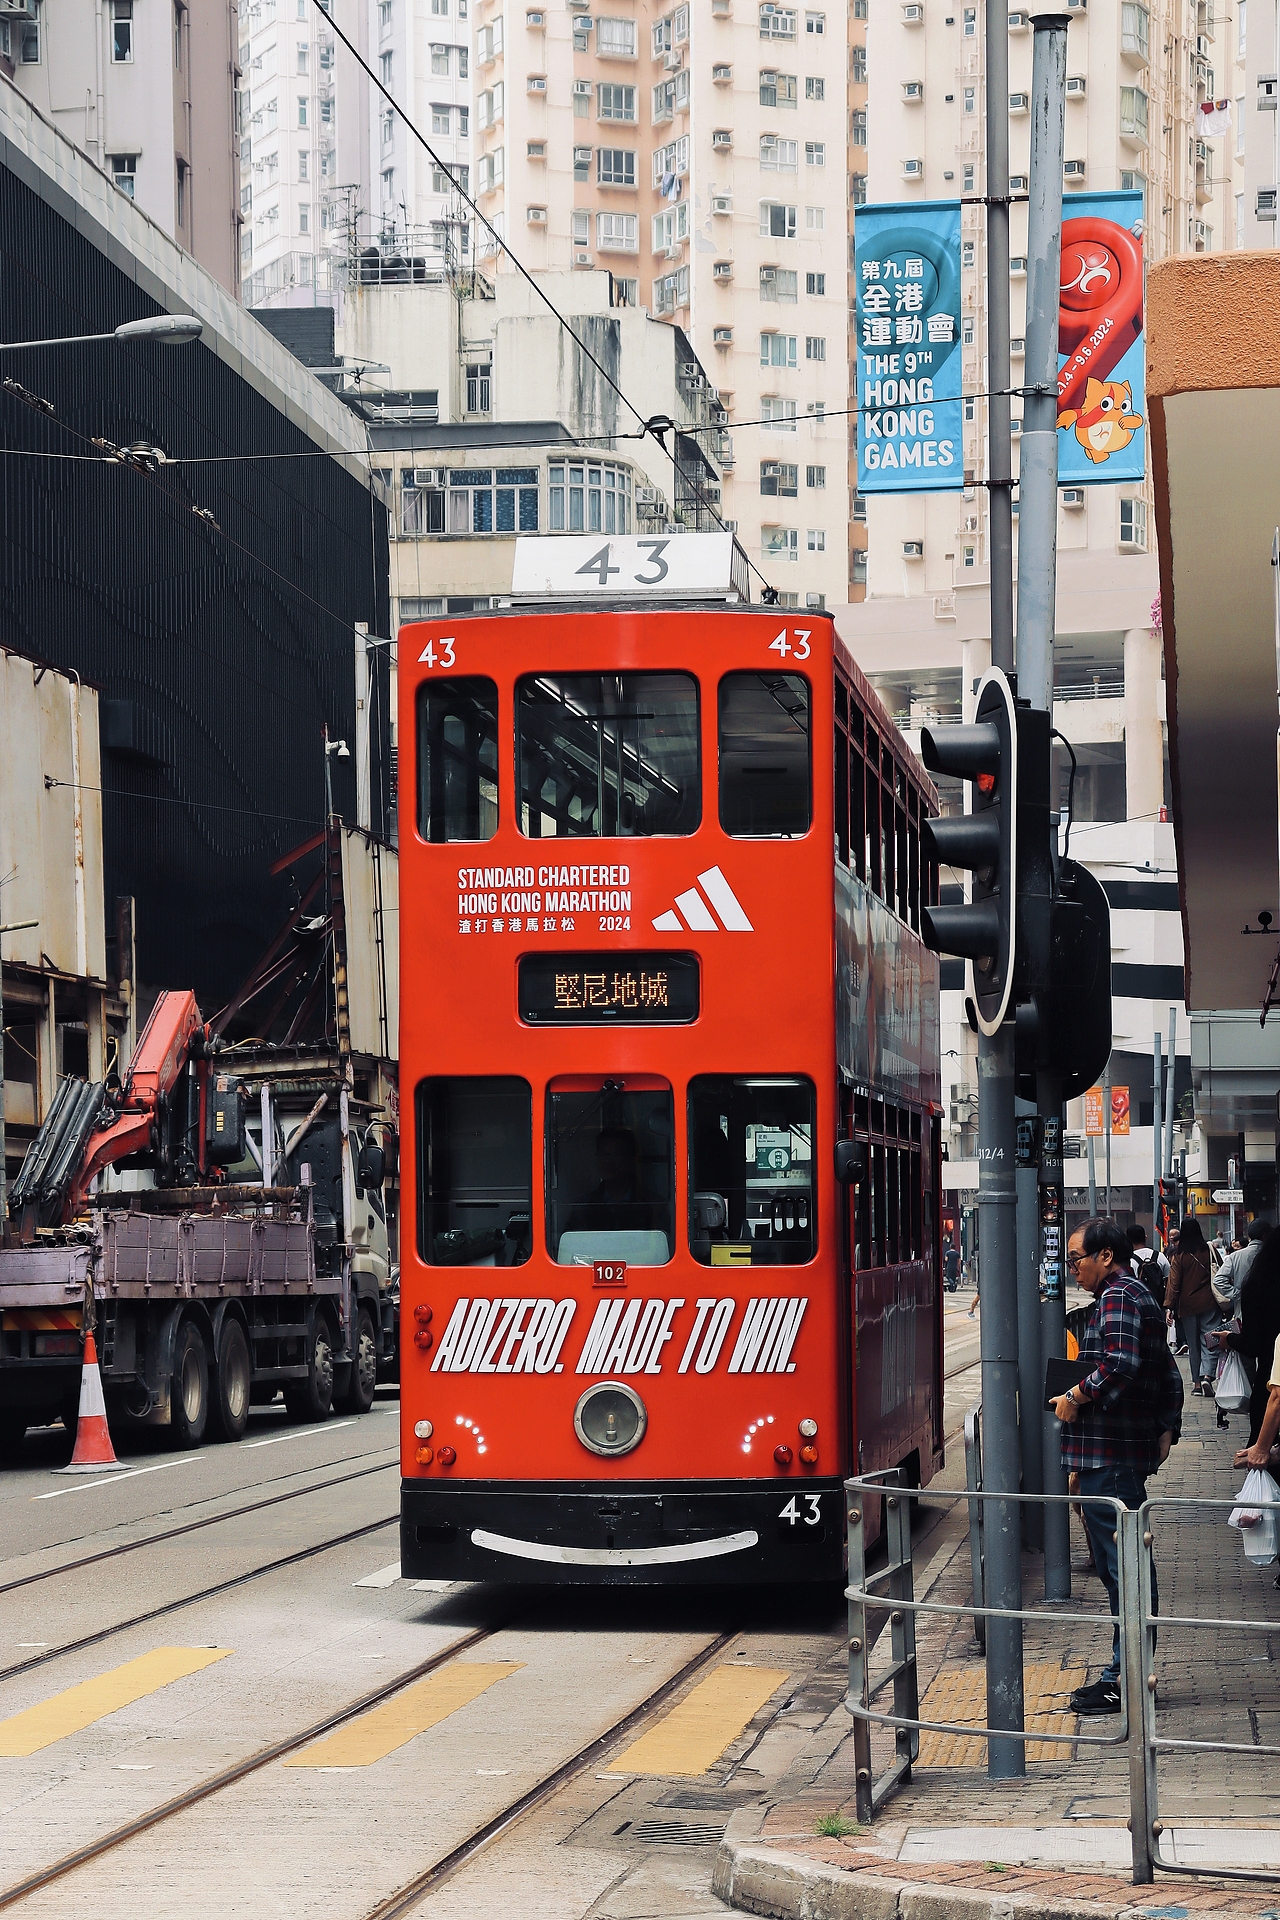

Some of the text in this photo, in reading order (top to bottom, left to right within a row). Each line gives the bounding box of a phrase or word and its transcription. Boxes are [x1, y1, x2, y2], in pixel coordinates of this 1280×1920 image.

[861, 259, 924, 280] 第九屆
[862, 283, 924, 313] 全港
[862, 312, 955, 346] 運動會
[862, 351, 933, 375] THE 9TH
[864, 377, 934, 407] HONG
[864, 409, 935, 439] KONG
[864, 440, 954, 470] GAMES
[574, 539, 672, 585] 43
[417, 637, 456, 669] 43
[767, 629, 812, 660] 43
[458, 865, 630, 889] STANDARD CHARTERED
[458, 890, 632, 915] HONG KONG MARATHON
[458, 916, 575, 934] 渣打香港馬拉松
[599, 916, 631, 931] 2024
[554, 972, 668, 1009] 堅尼地城
[596, 1266, 624, 1280] 102
[430, 1298, 808, 1374] ADIZERO. MADE TO WIN.
[777, 1494, 822, 1526] 43
